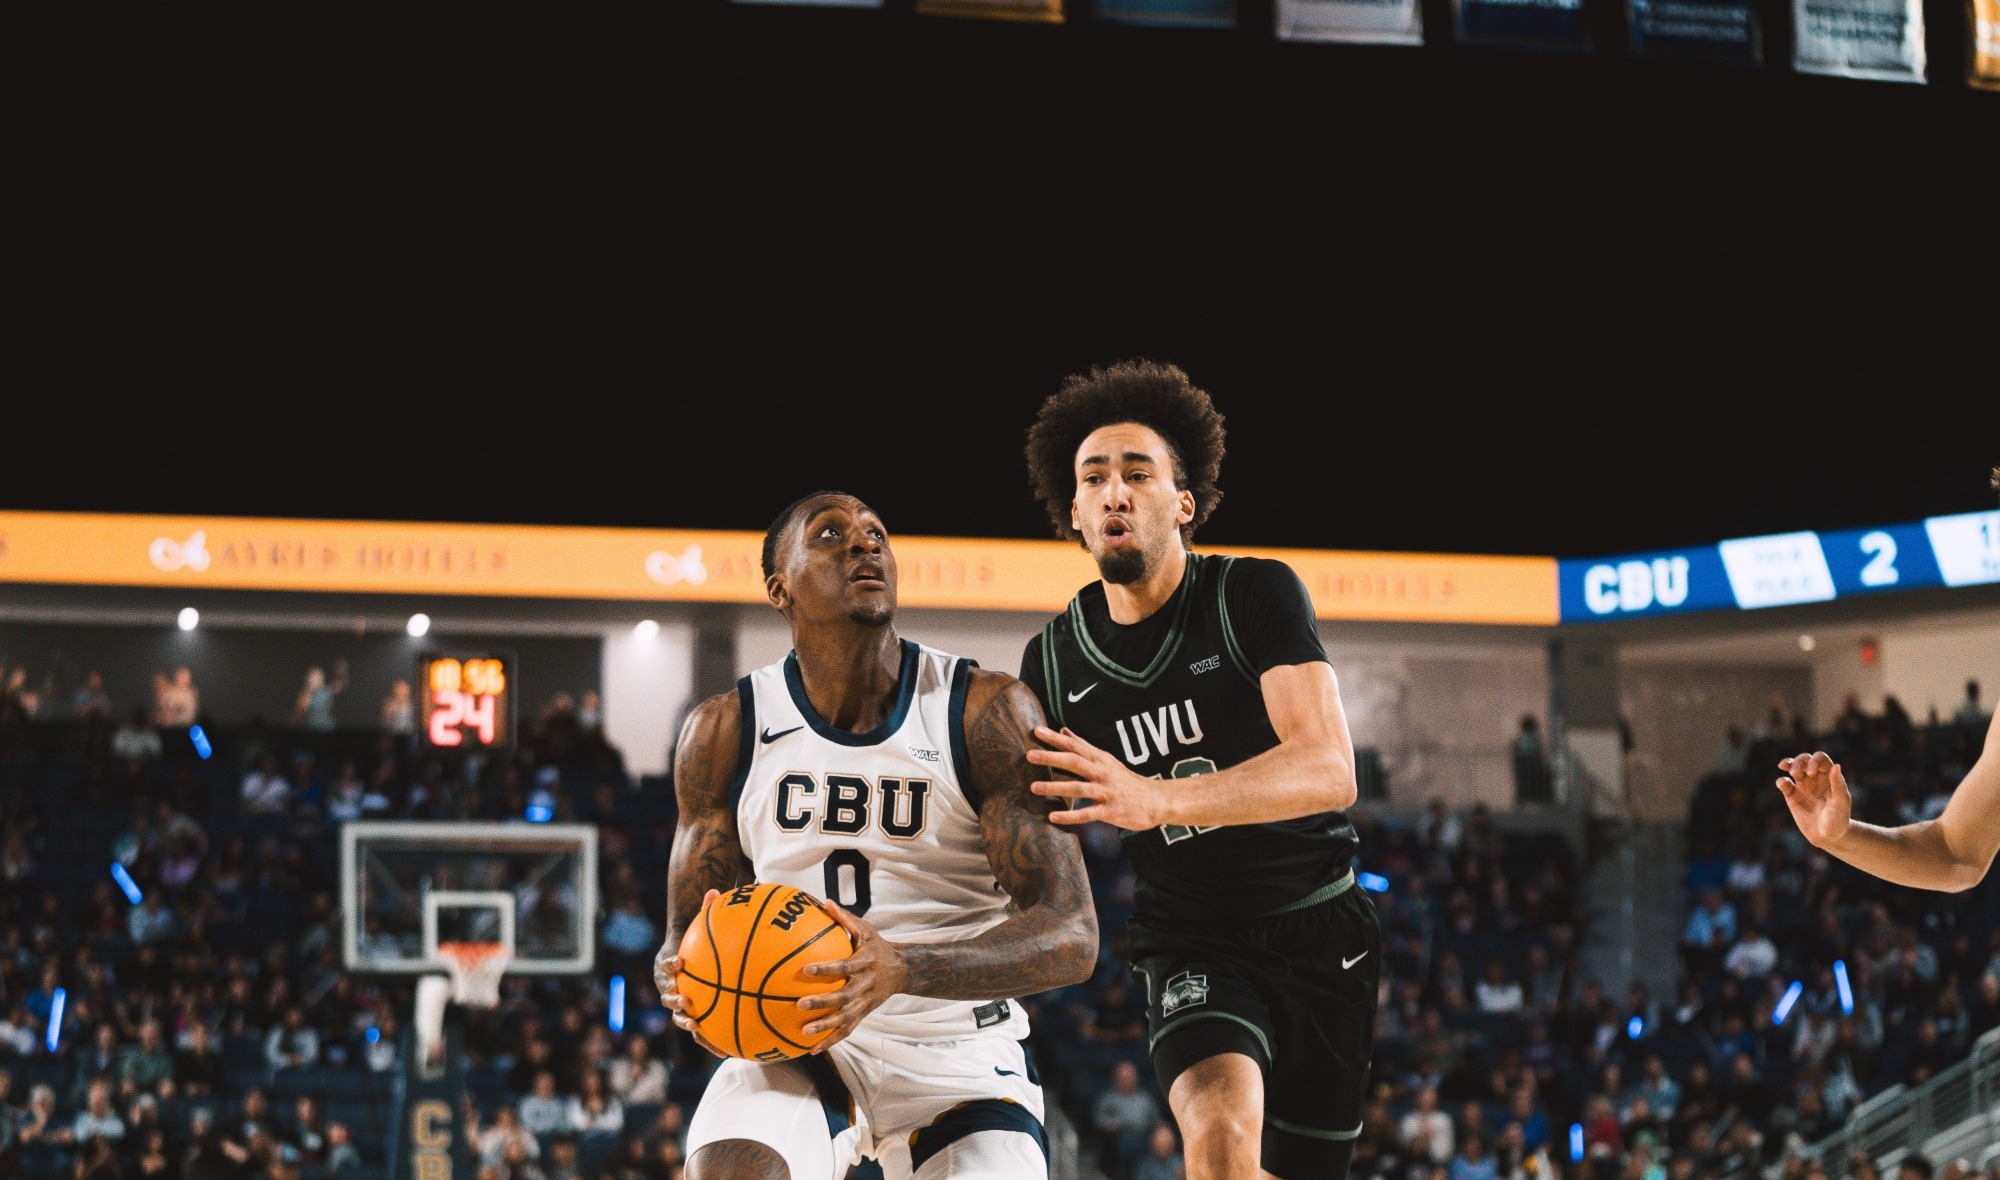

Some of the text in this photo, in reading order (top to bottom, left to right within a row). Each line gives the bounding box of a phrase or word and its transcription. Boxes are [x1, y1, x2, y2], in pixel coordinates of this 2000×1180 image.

[1583, 556, 1690, 614] CBU
[1859, 531, 1899, 587] 2
[1190, 655, 1220, 675] WAC
[428, 689, 495, 747] 24
[1115, 699, 1204, 766] UVU
[909, 747, 940, 762] WAC
[774, 771, 931, 841] CBU
[824, 848, 871, 918] 0
